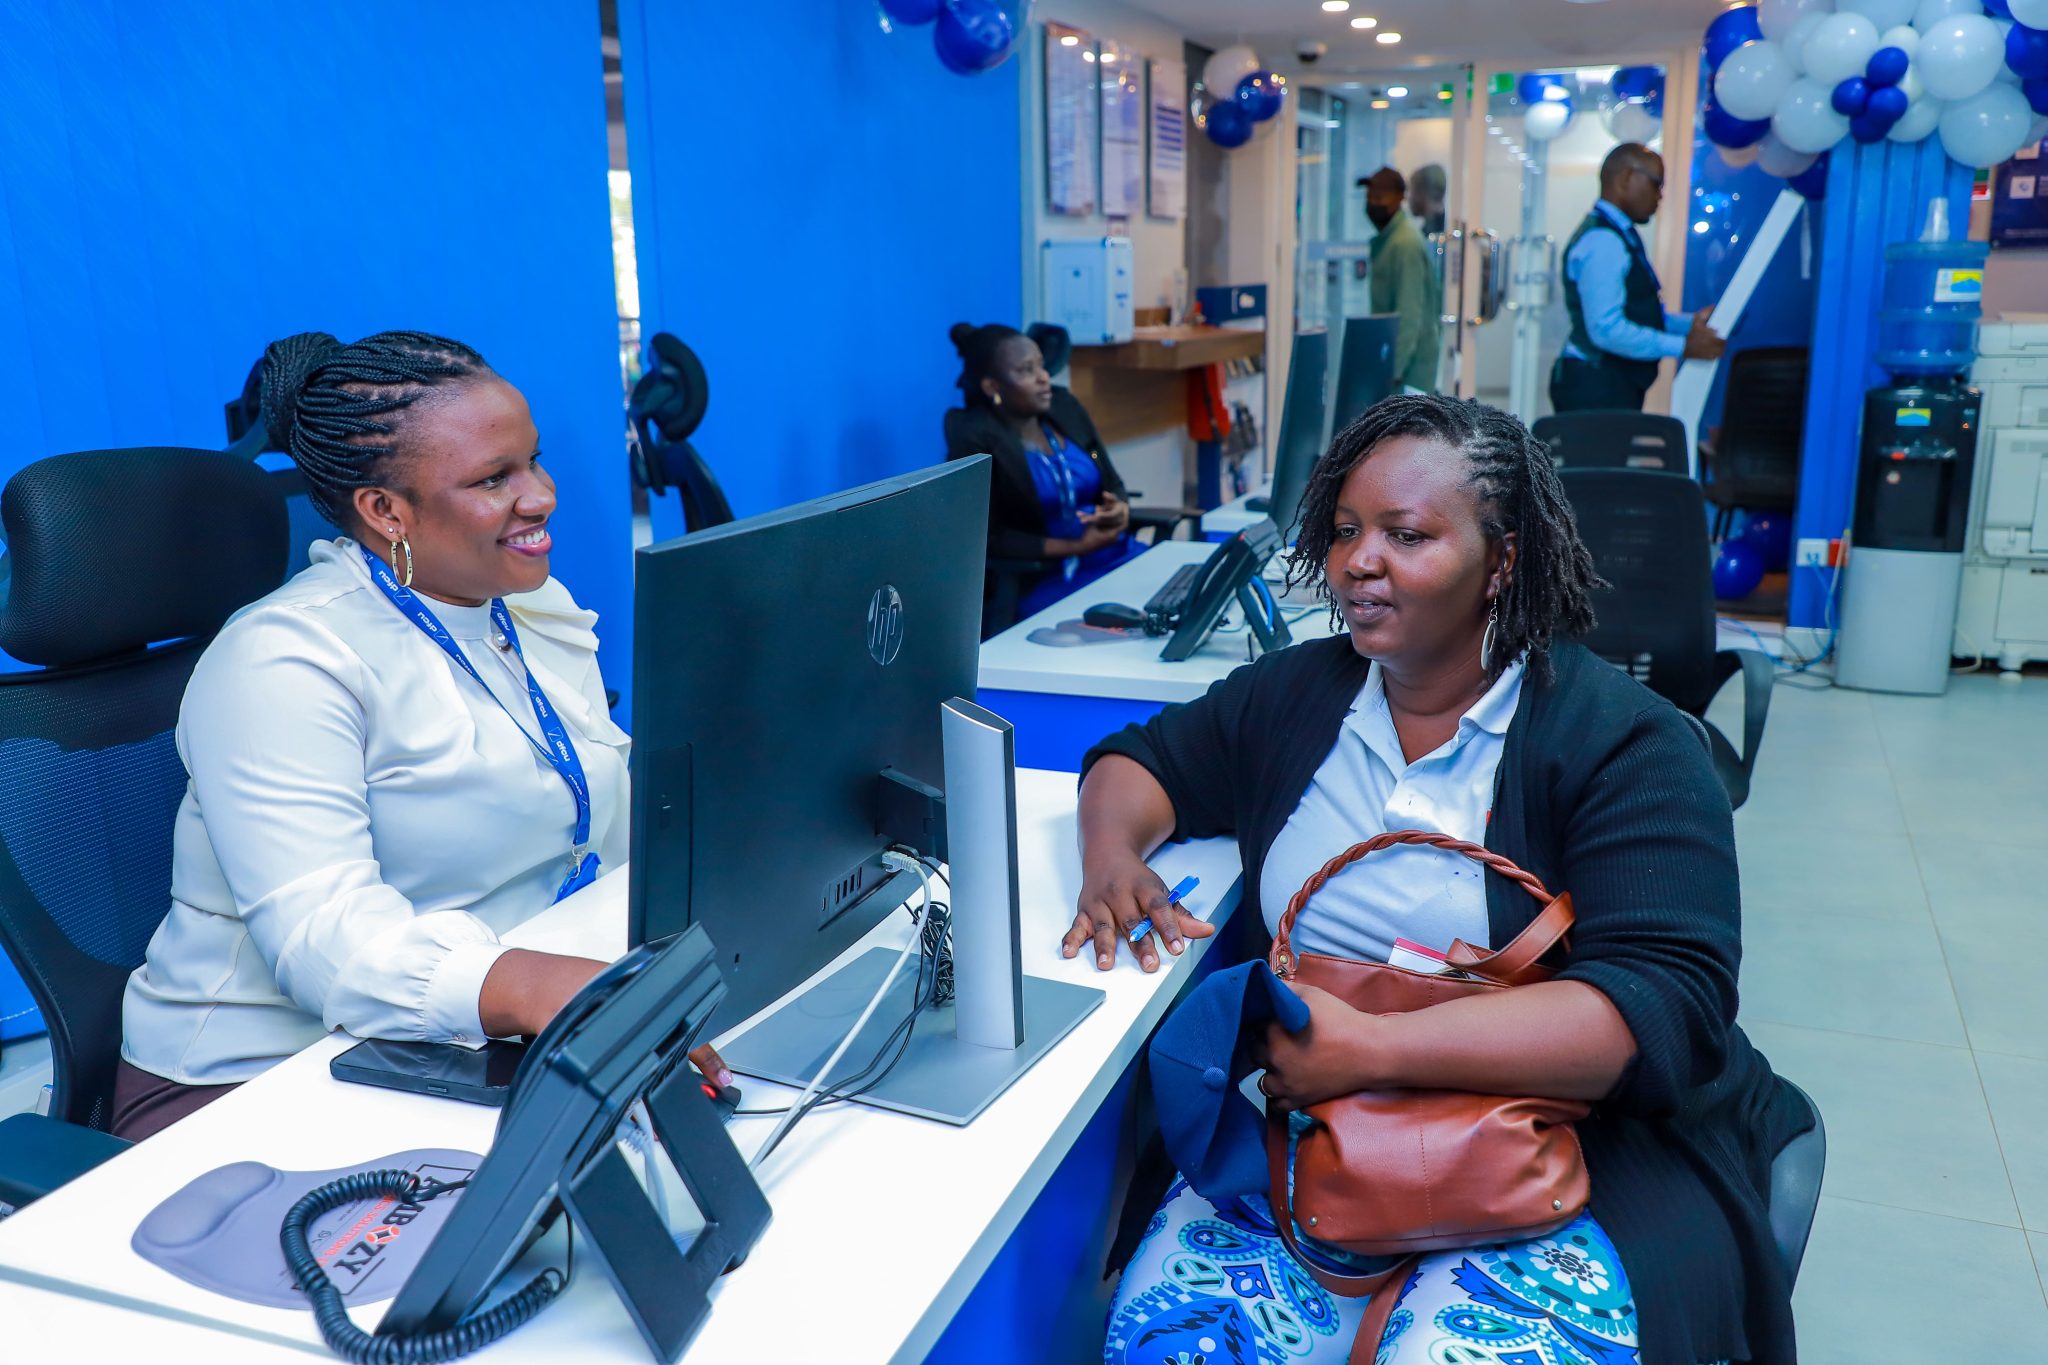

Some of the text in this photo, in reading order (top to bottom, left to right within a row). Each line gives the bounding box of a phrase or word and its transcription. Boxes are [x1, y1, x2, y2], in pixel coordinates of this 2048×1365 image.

[379, 570, 399, 592] dfcu
[418, 612, 437, 632] dfcu
[496, 612, 510, 631] dfcu
[535, 696, 548, 718] dfcu
[556, 740, 571, 762] dfcu
